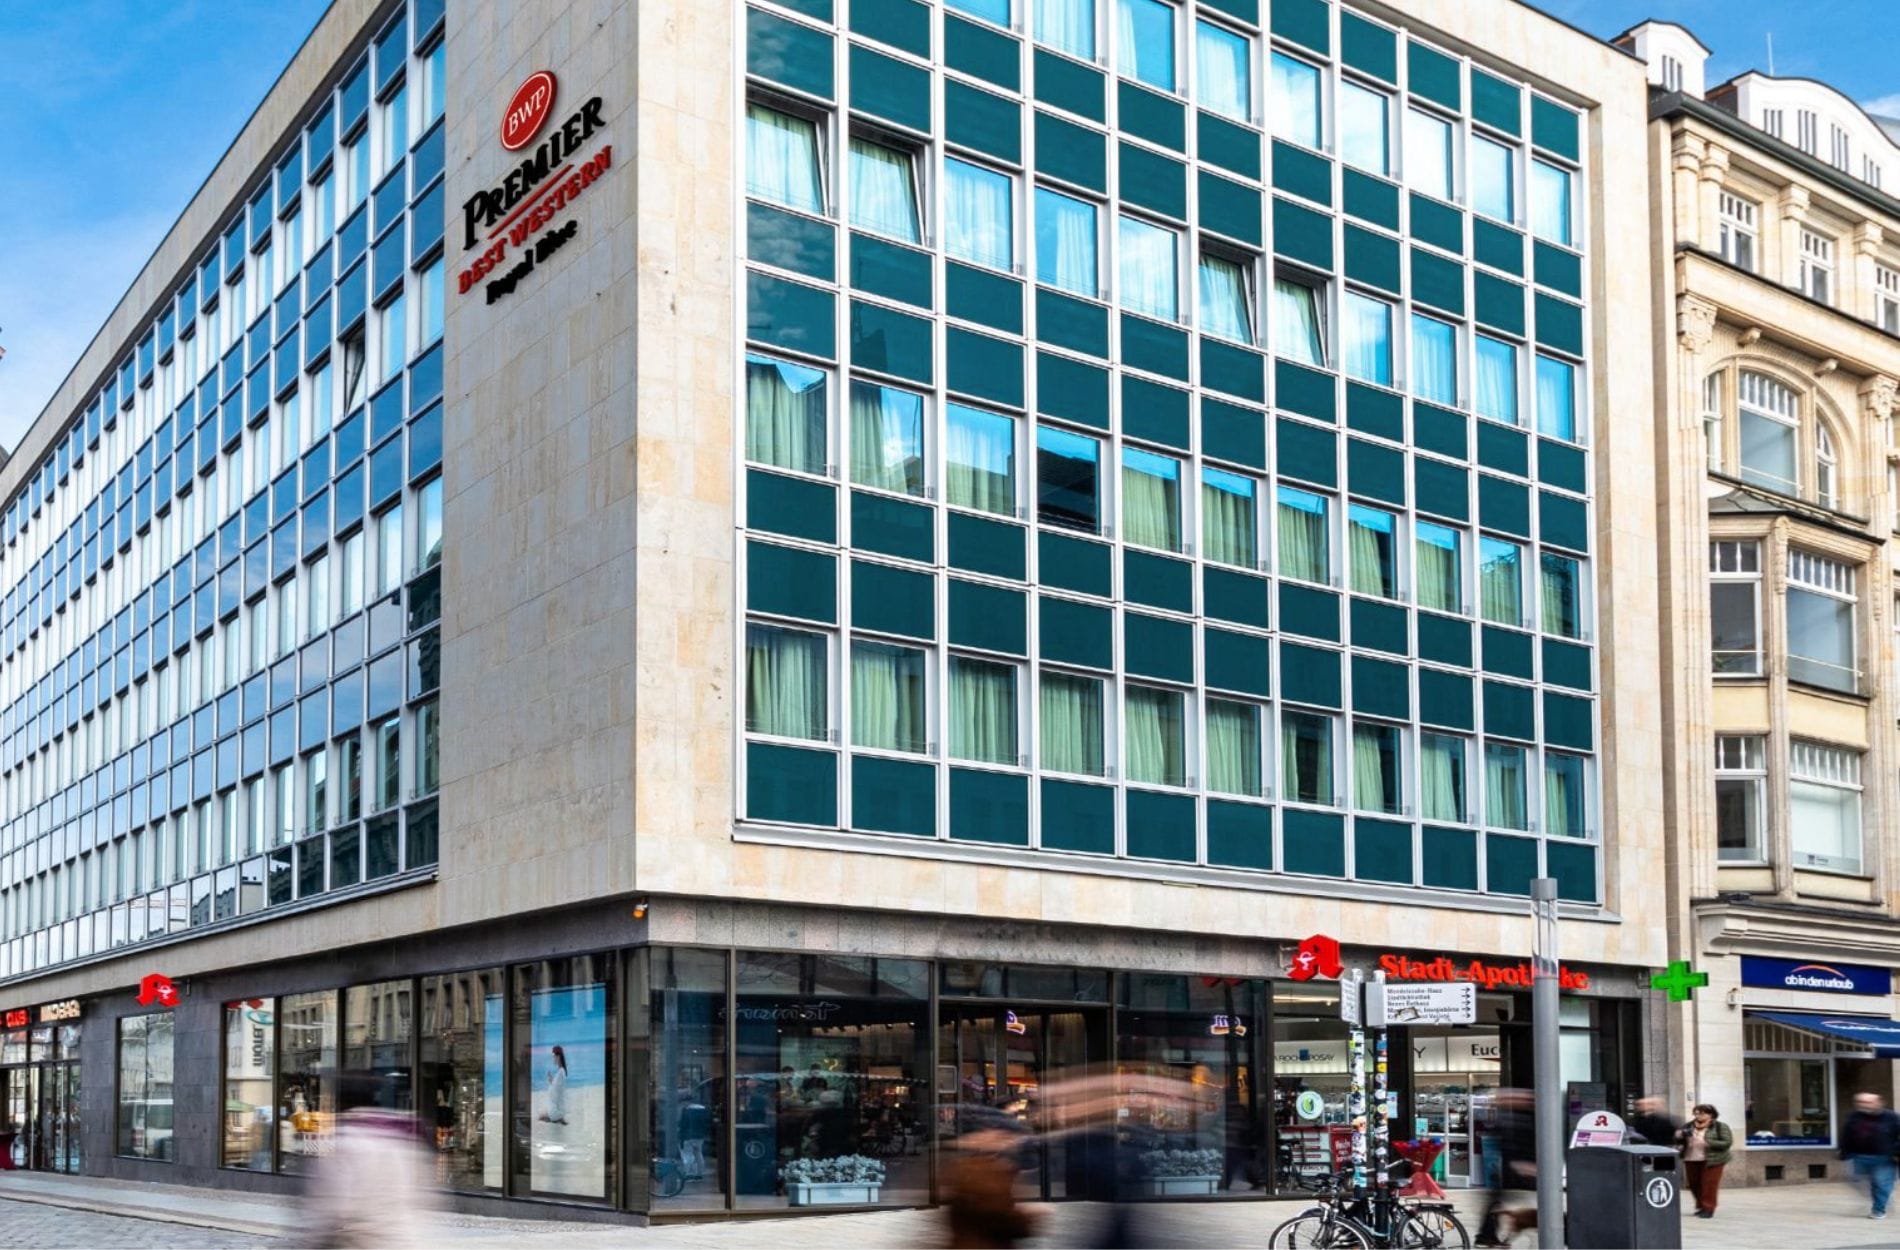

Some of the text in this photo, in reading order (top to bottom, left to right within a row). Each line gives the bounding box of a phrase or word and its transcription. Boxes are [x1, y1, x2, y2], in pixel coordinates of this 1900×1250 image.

[508, 86, 546, 137] BWP
[458, 145, 612, 294] BEST WESTERN
[462, 97, 606, 251] PREMIER
[1379, 954, 1590, 989] Stadt-Apotke
